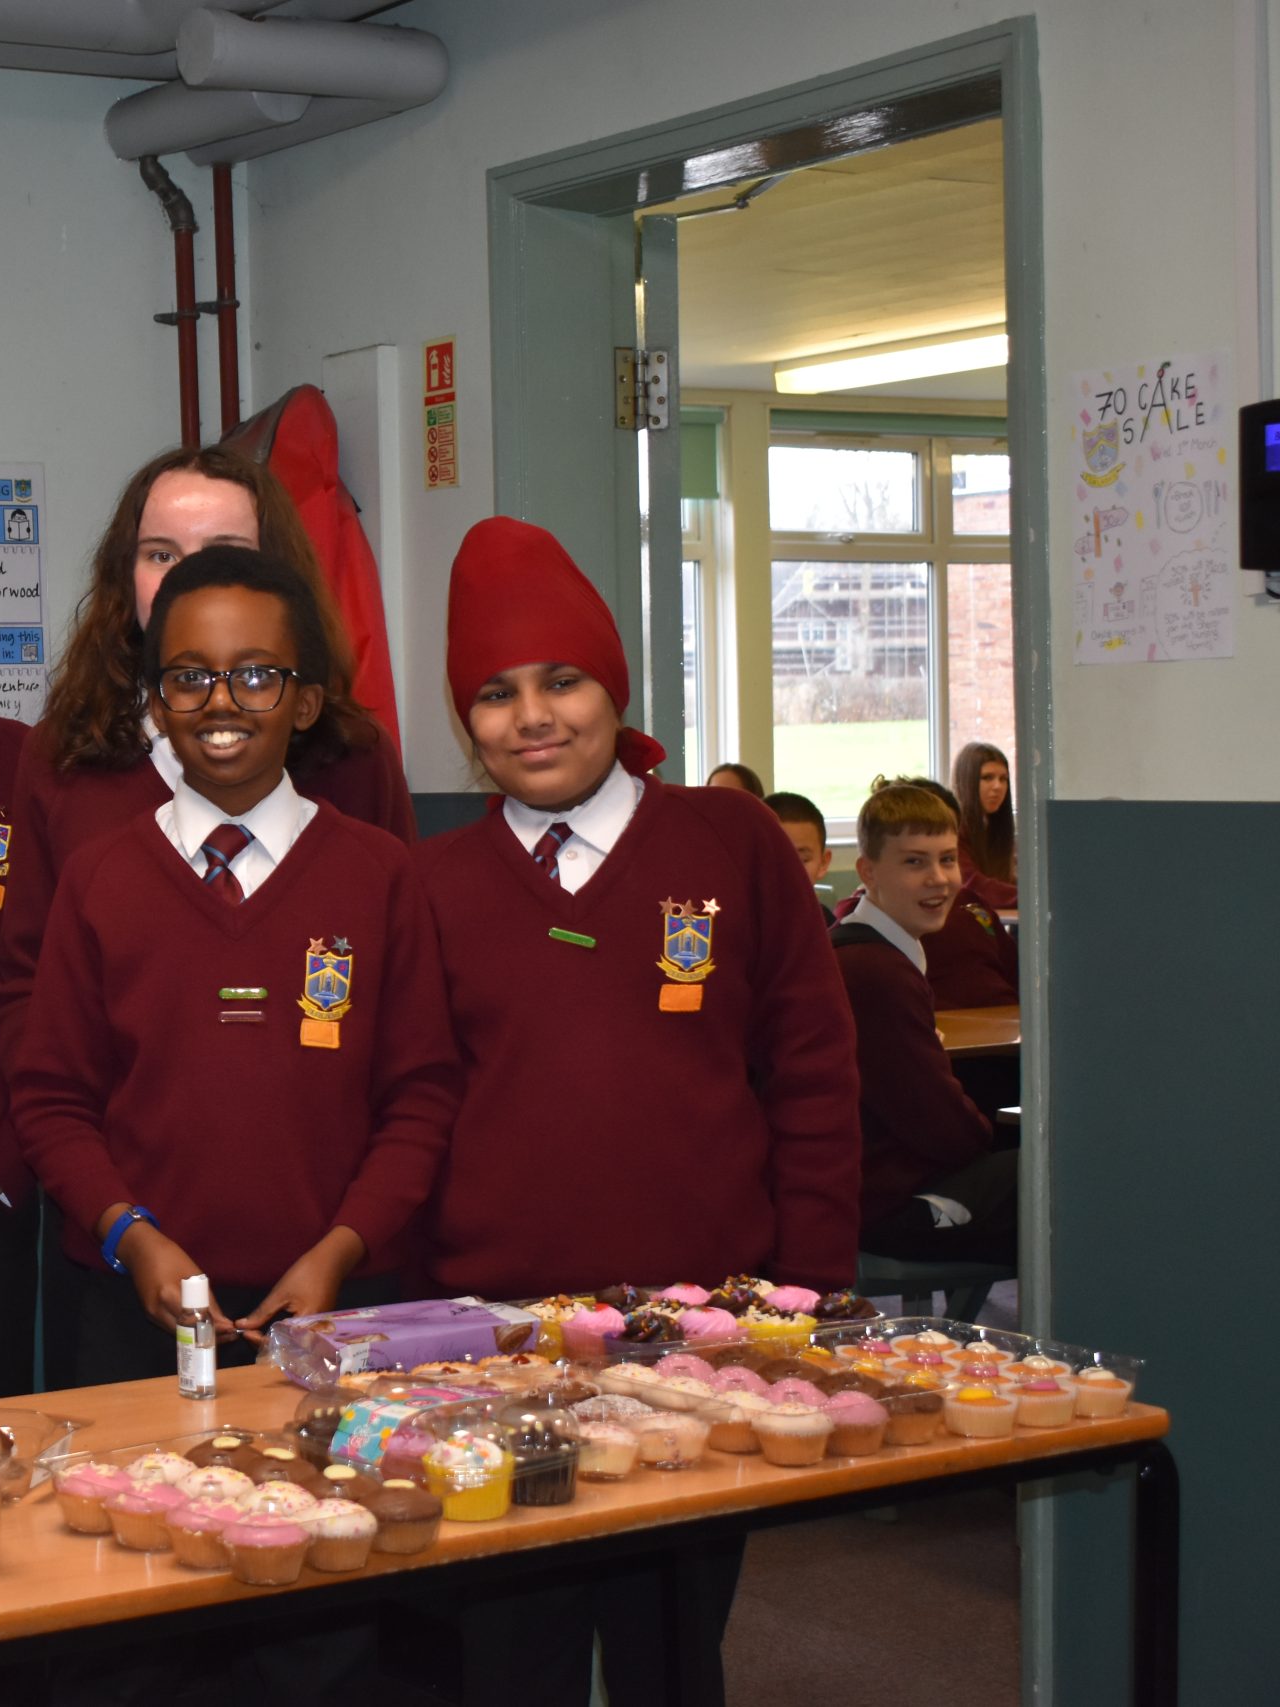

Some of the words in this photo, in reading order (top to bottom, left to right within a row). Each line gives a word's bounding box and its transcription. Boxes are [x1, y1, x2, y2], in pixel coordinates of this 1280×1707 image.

[1138, 372, 1197, 414] CAKE
[1123, 401, 1205, 444] SALE
[18, 629, 40, 642] this
[2, 648, 15, 658] in:
